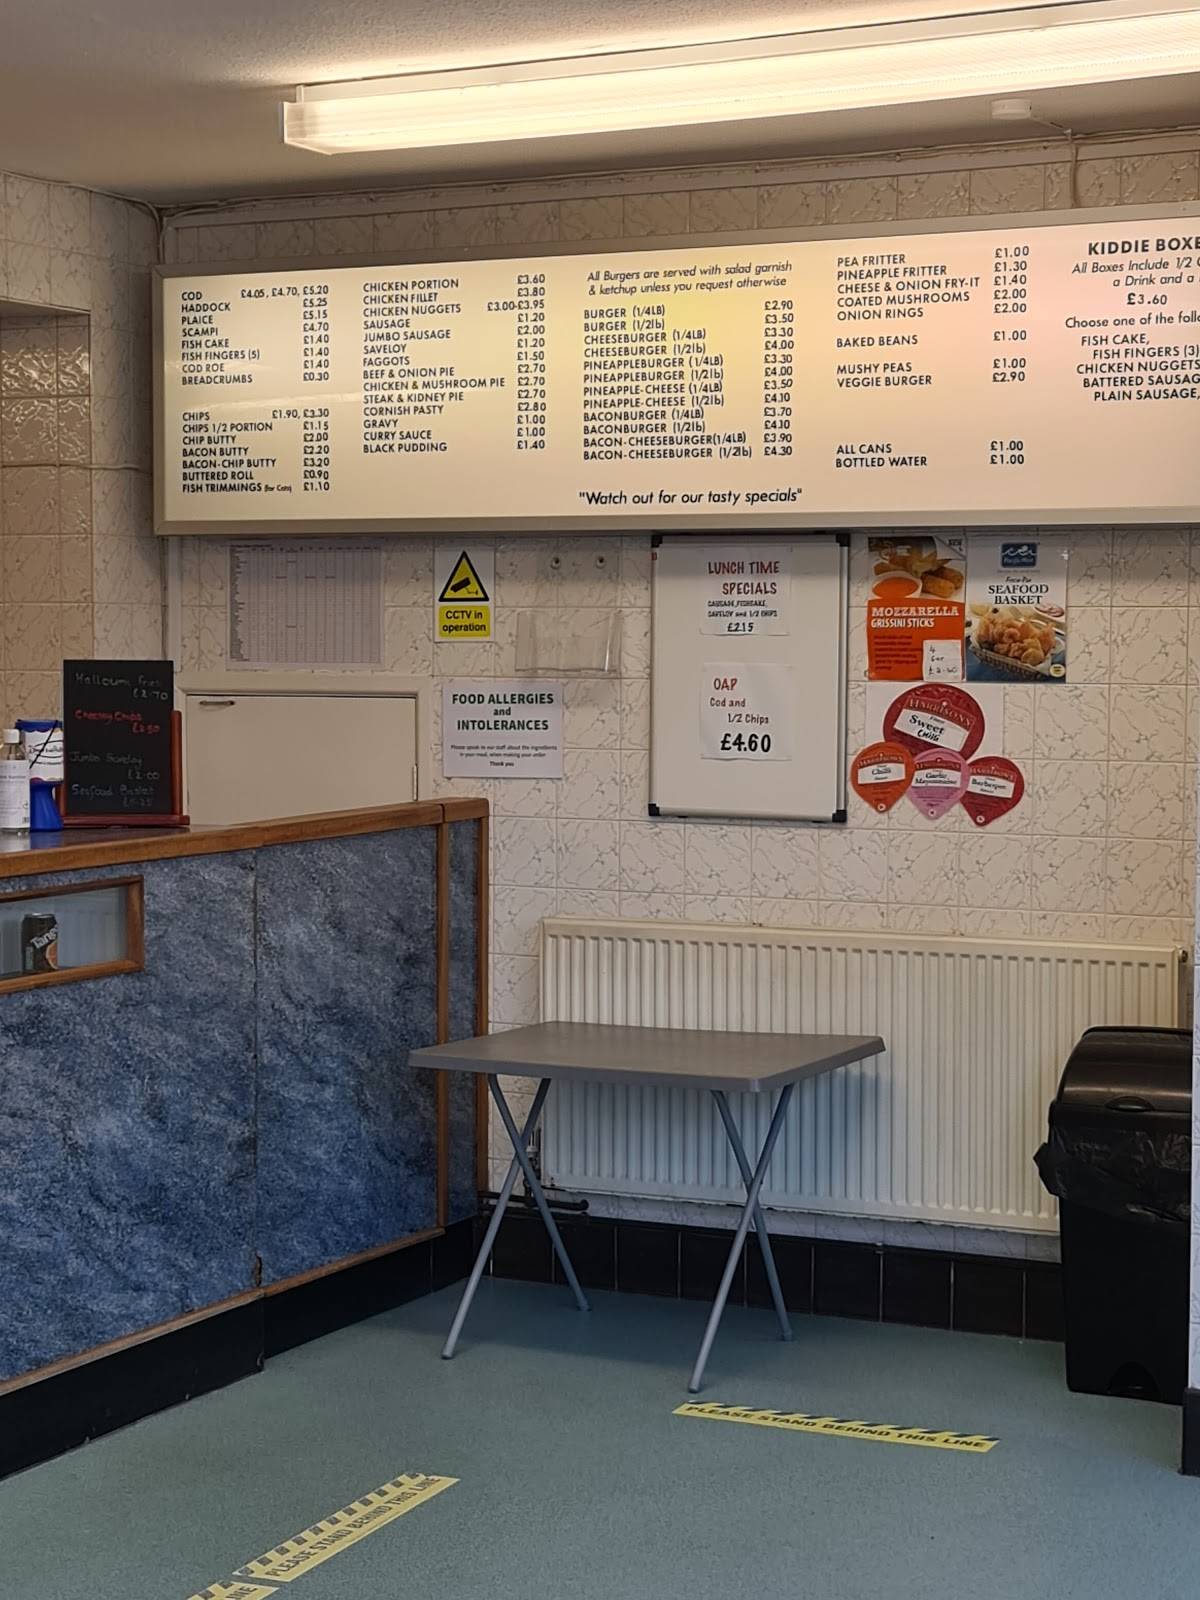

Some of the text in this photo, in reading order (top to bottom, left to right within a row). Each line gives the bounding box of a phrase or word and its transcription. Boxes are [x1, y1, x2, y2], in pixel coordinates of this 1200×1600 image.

[1089, 240, 1150, 255] KIDDIE
[838, 246, 1030, 267] PEA FRITTER £1.00
[588, 261, 792, 283] All Burgers are served with salad garnish
[837, 261, 1027, 281] PINEAPPLE FRITTER £1.30
[1072, 257, 1192, 274] All Boxes Include 1/2
[363, 274, 545, 293] CHICKEN PORTION £3.60
[838, 275, 1027, 294] CHEESE & ONION FRY-IT £1.40
[1113, 272, 1195, 287] a Drink and a
[589, 277, 787, 296] & ketchup unless you request otherwise
[182, 292, 202, 301] COD
[272, 288, 300, 297] £4.70,
[303, 286, 328, 295] £5.20
[1127, 293, 1168, 305] £3.60
[584, 301, 793, 319] BURGER (1/4LB) £2.90
[1066, 316, 1108, 328] Choose
[1113, 317, 1135, 327] one
[1140, 313, 1153, 325] of
[1155, 313, 1174, 324] the
[837, 330, 1027, 348] BAKED BEANS £1.00
[1081, 333, 1150, 346] FISH CAKE,
[584, 340, 794, 358] CHEESEBURGER (1/2lb) £4.00
[1093, 349, 1120, 360] FISH
[1124, 346, 1180, 358] FINGERS
[363, 364, 545, 379] BEEF & ONION PIE £2.70
[1077, 362, 1134, 374] CHICKEN
[1083, 376, 1144, 388] BATTERED
[1094, 391, 1132, 402] PLAIN
[182, 409, 329, 421] CHIPS £1.90, £3.30
[363, 440, 545, 453] BLACK PUDDING £1.40
[182, 458, 329, 469] BACON-CHIP BUTTY £3.20
[836, 455, 1024, 468] BOTTLED WATER £1.00
[579, 488, 802, 506] "Watch out for our tasty specials"
[708, 561, 780, 574] LUNCH TIME
[722, 582, 777, 595] SPECIALS
[988, 585, 1049, 594] SEAFOOD
[994, 596, 1043, 605] BASKET
[446, 610, 483, 620] CCTV in
[872, 607, 960, 617] MOZZARELLA
[442, 623, 486, 633] operation
[871, 619, 935, 628] GRISSINI STICKS
[452, 694, 554, 704] FOOD ALLERGIES
[710, 698, 746, 707] Cod and
[493, 707, 511, 716] and
[457, 720, 549, 731] INTOLERANCES
[728, 713, 769, 725] 1/2 Chips
[909, 715, 945, 734] Sweet
[720, 733, 771, 753] £4.60
[686, 1406, 985, 1448] PLEASE STAND BEHIND THIS LINE
[264, 1547, 316, 1577] PLEASE
[309, 1529, 354, 1553] STAND
[386, 1491, 418, 1508] THIS
[413, 1477, 441, 1493] LINE
